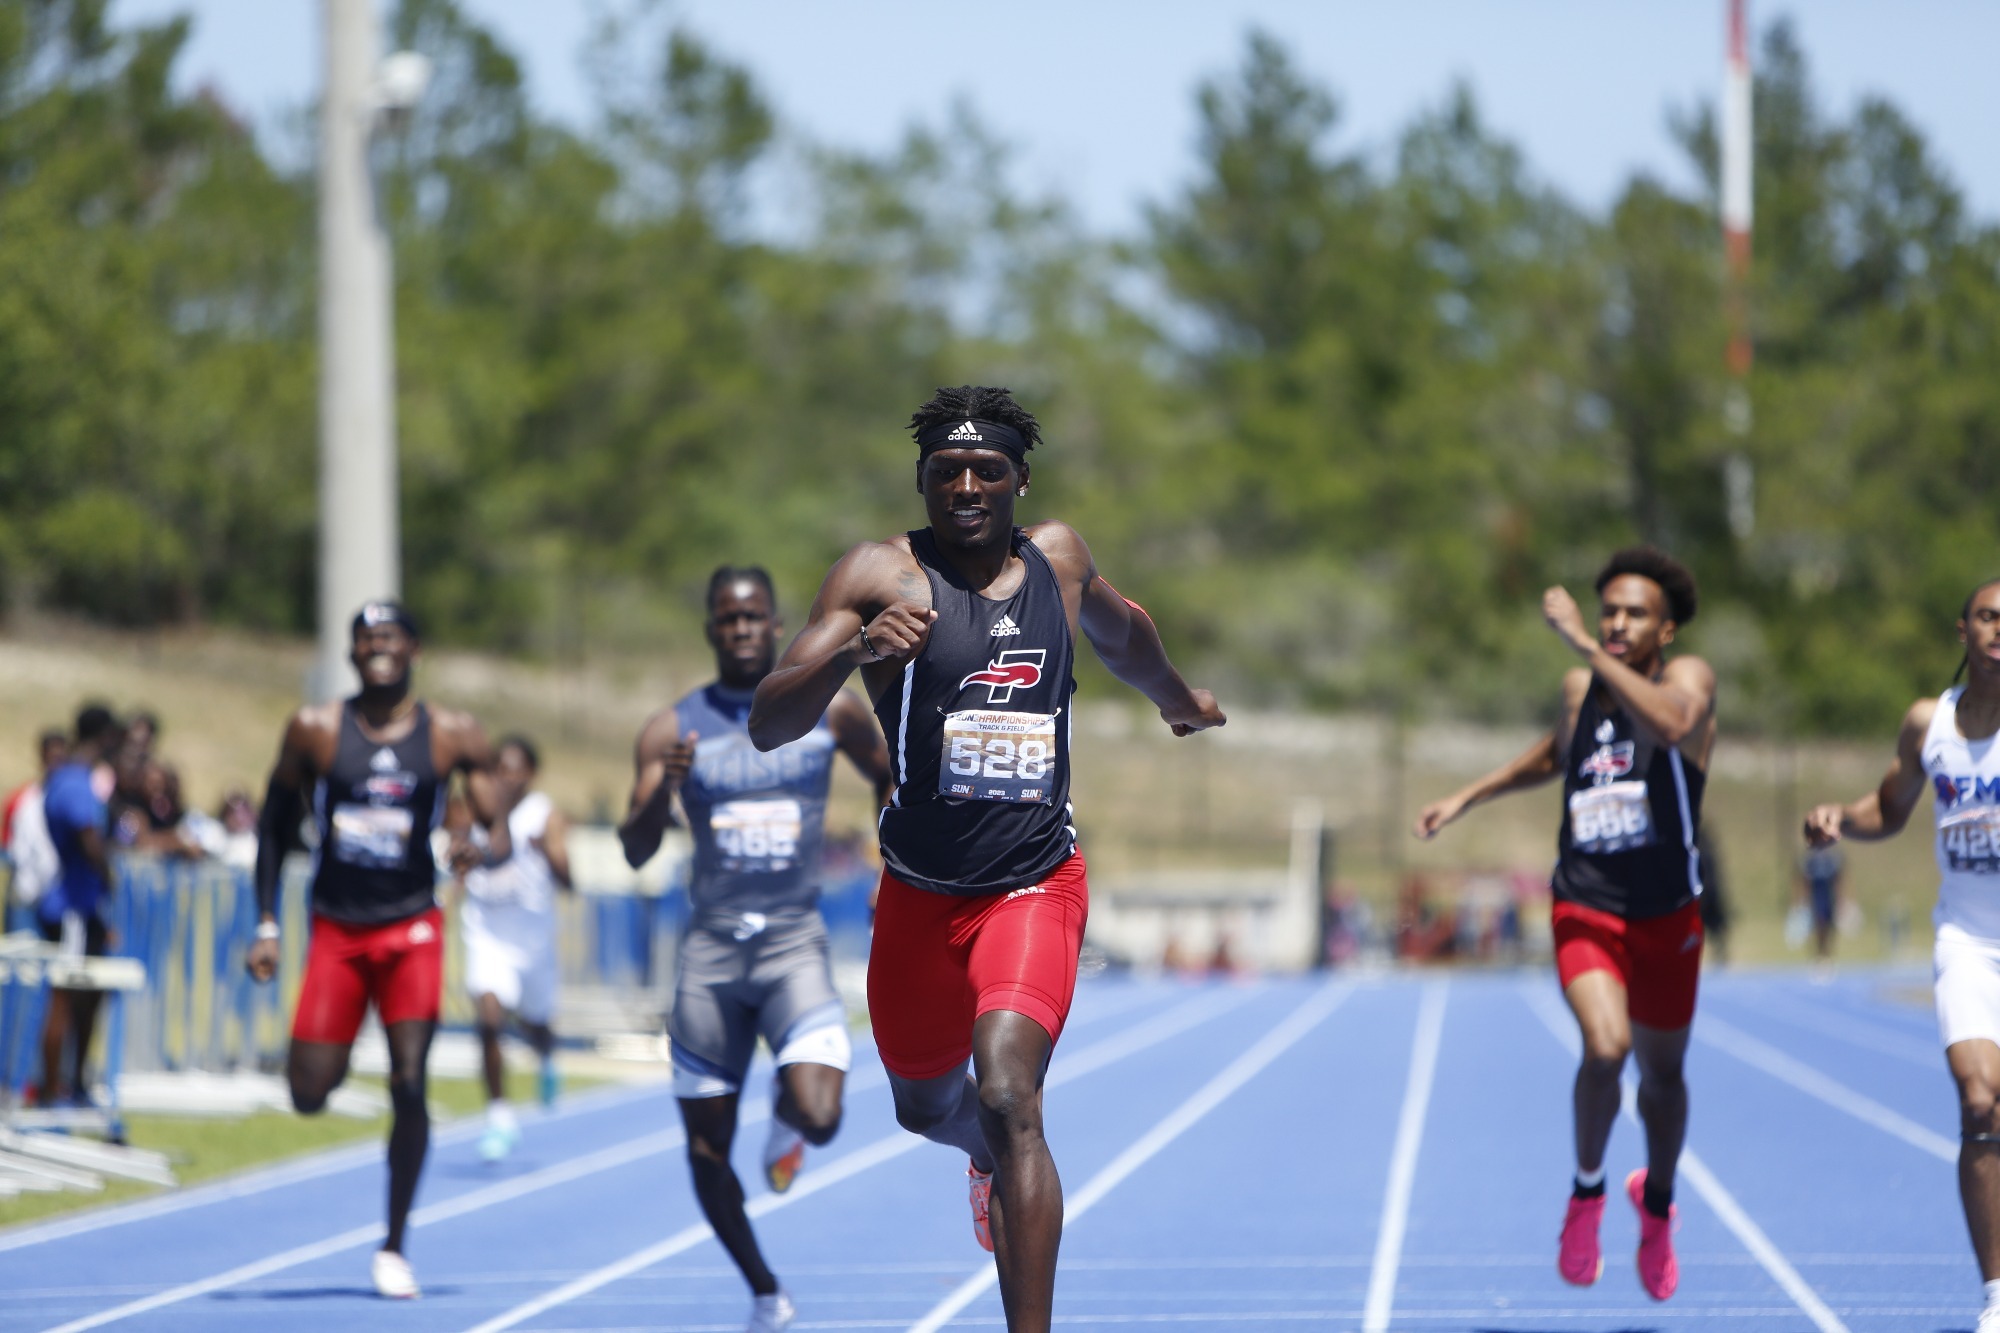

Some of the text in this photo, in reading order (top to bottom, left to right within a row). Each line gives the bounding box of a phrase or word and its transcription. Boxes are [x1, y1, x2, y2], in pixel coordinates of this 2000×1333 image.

[948, 433, 983, 441] adidas
[990, 627, 1021, 637] adidas
[949, 736, 1047, 780] 528
